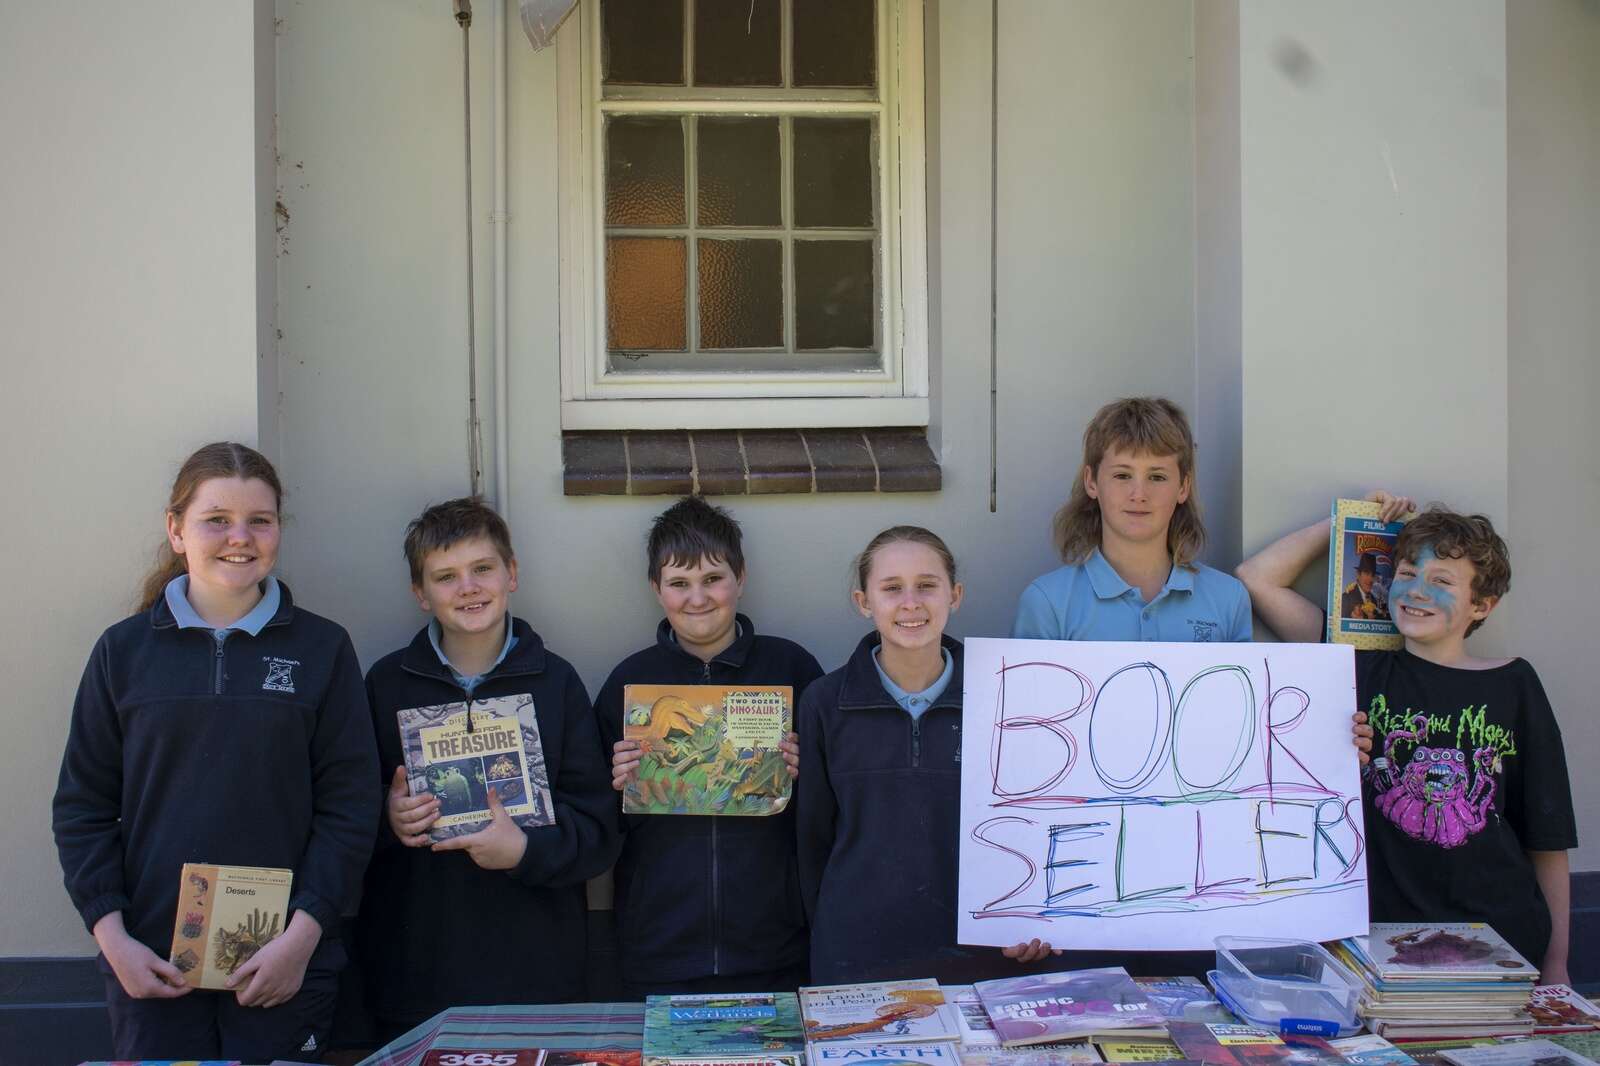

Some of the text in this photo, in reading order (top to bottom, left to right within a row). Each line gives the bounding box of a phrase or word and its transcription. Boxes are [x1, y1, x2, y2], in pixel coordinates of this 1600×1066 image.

[1363, 521, 1386, 531] FILMS
[1349, 619, 1392, 632] MEDIA STORY
[729, 705, 780, 715] DINOSAURS
[483, 724, 502, 733] FOR
[427, 730, 518, 759] TREASURE
[452, 812, 488, 823] CATHERINE
[971, 797, 1365, 910] SELLERS
[225, 886, 256, 896] Deserts
[993, 997, 1074, 1014] fabric
[1009, 1008, 1036, 1019] to
[1112, 1001, 1149, 1013] for
[438, 1053, 519, 1066] 365
[822, 1048, 943, 1059] EARTH
